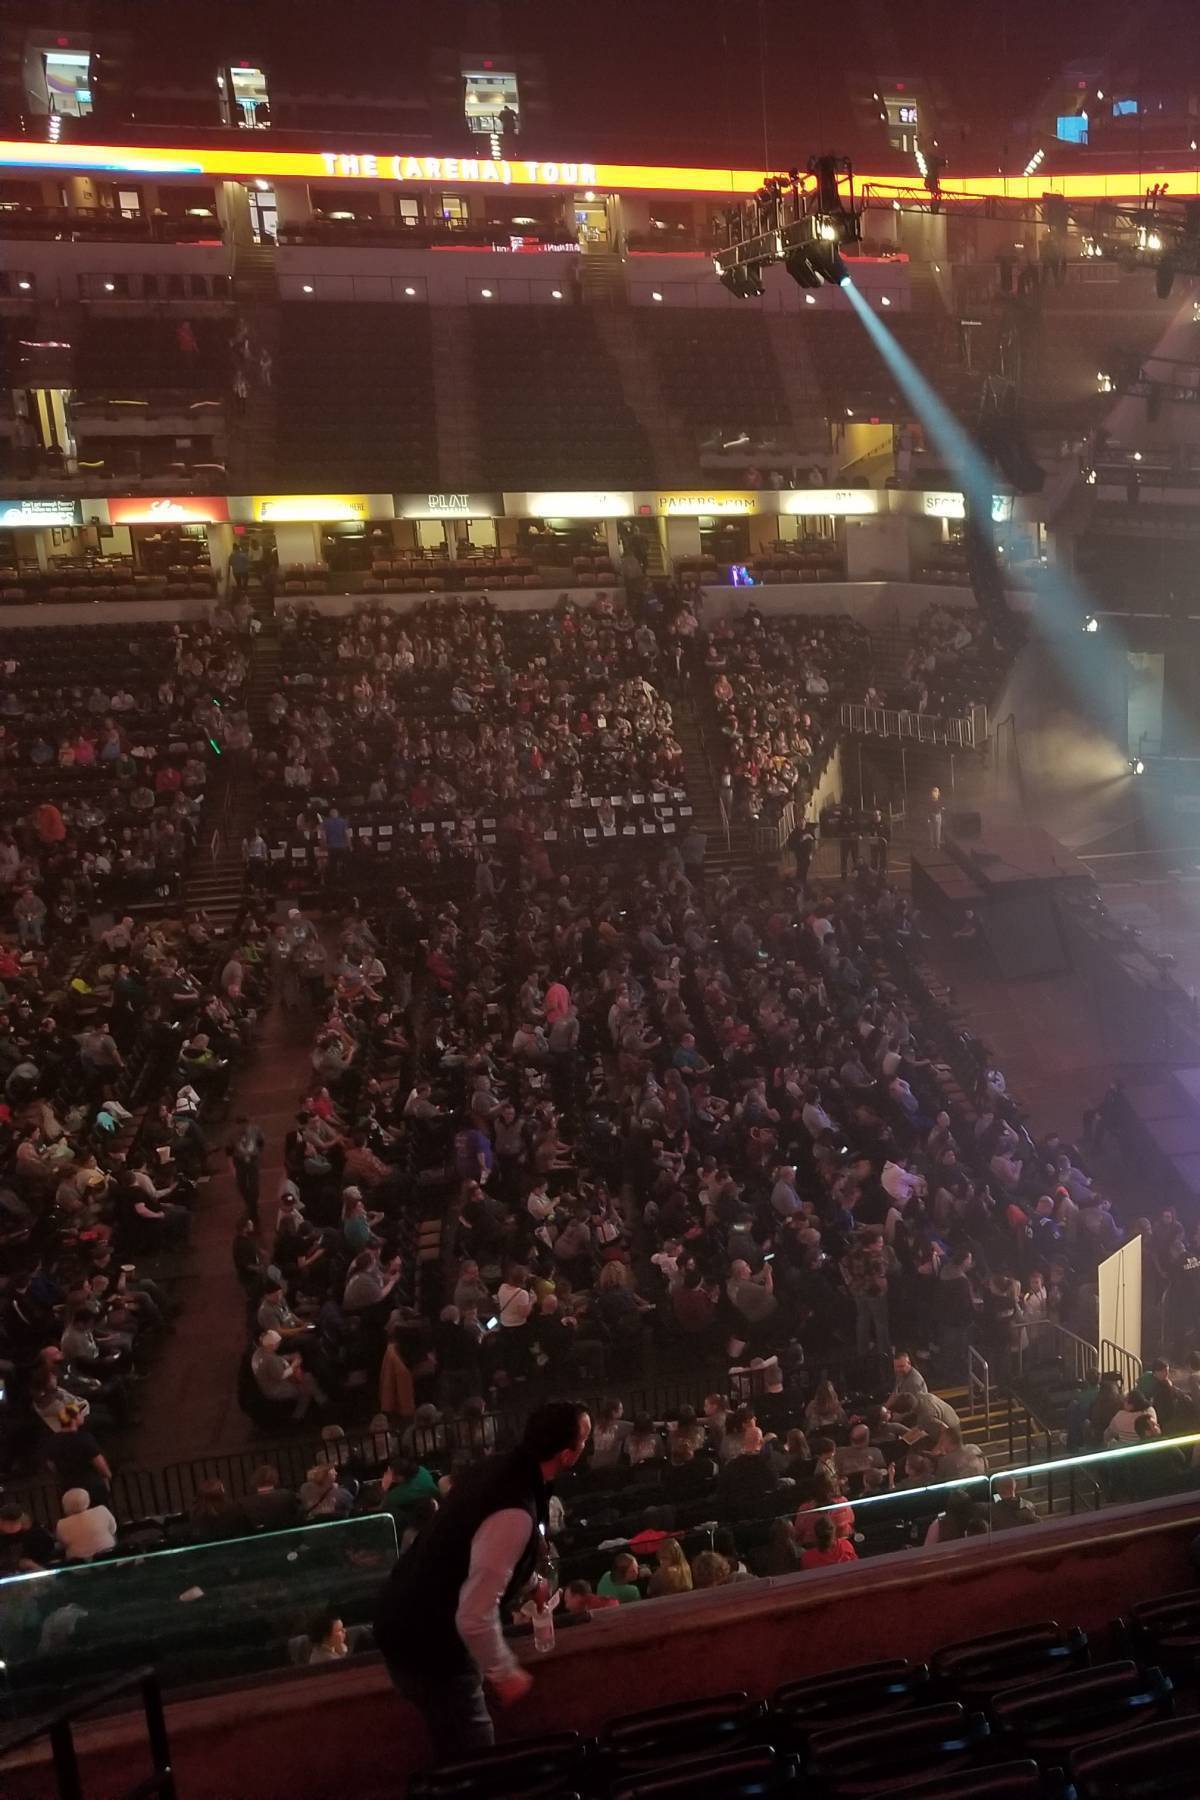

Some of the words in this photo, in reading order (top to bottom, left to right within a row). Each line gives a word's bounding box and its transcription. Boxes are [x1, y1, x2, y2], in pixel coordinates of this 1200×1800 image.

[320, 153, 377, 176] THE
[392, 155, 512, 185] (ARENA)
[525, 162, 597, 183] TOUR
[428, 494, 469, 507] PLAT
